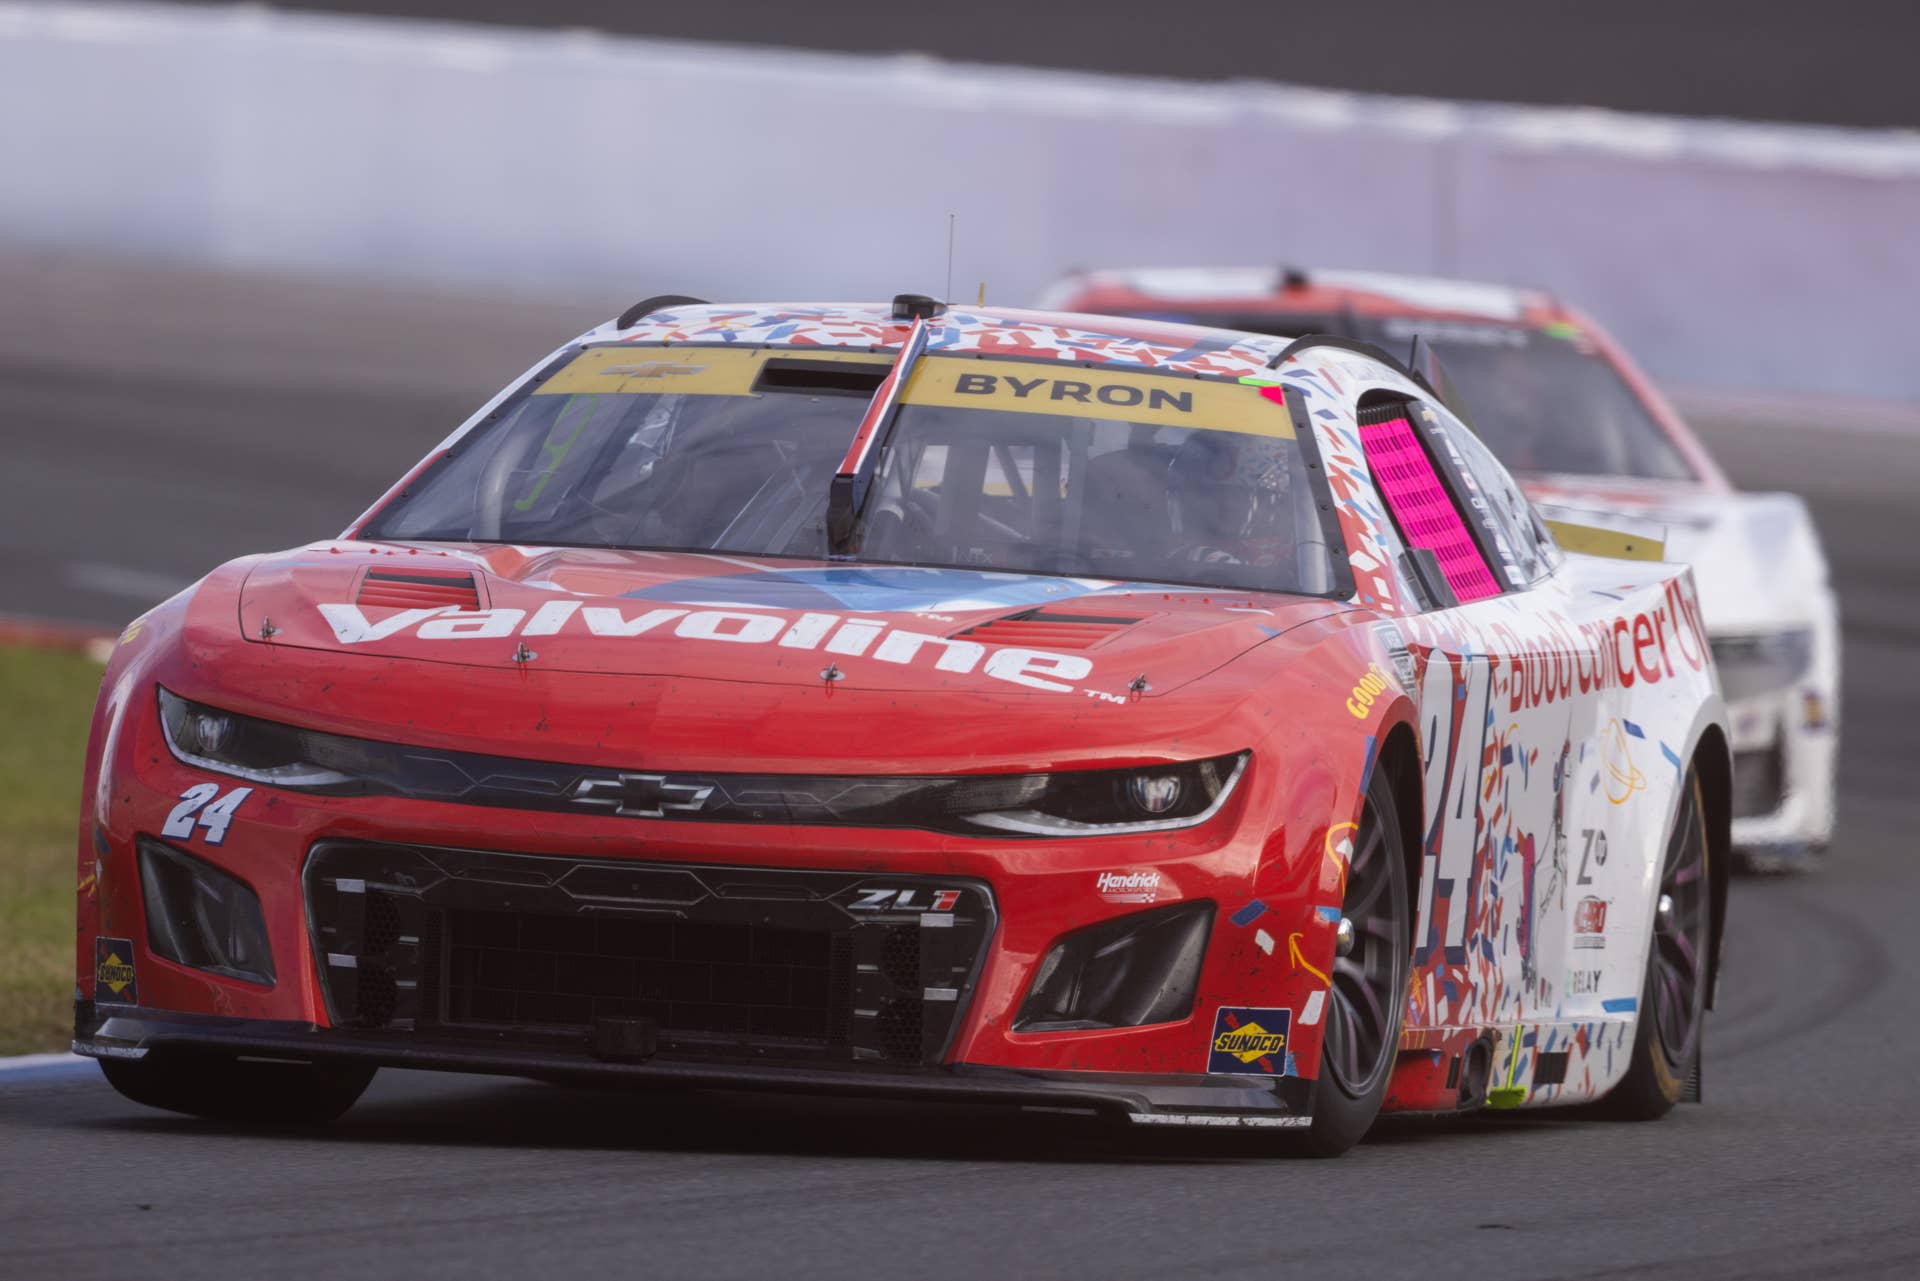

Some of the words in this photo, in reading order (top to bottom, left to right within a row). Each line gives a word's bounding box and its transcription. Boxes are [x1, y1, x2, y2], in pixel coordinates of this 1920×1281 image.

[954, 373, 1193, 413] BYRON
[317, 600, 1093, 693] Valvoline
[1490, 609, 1572, 713] Blood
[160, 782, 254, 847] 24
[1096, 872, 1161, 893] Hendrick
[847, 889, 962, 911] ZL1
[99, 964, 133, 983] SUNOCO
[1217, 1033, 1283, 1053] SUNOCO
